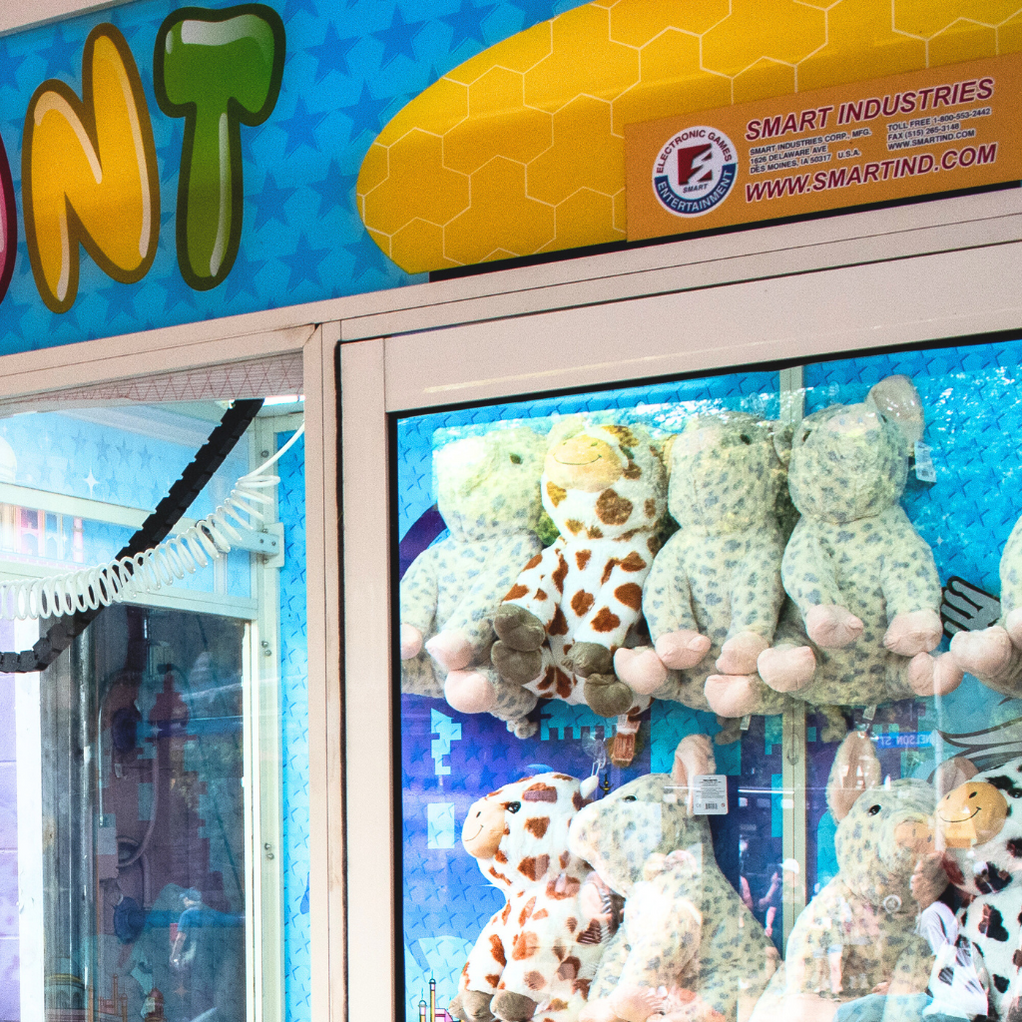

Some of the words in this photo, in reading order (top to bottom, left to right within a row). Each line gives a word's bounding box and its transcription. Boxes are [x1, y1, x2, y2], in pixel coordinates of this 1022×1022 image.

[745, 106, 833, 140] SMART
[838, 78, 994, 124] INDUSTRIES
[888, 123, 908, 131] TOLL
[910, 118, 931, 127] FREE
[934, 108, 991, 123] 1-800-553-2442
[750, 144, 776, 156] SMART
[777, 137, 823, 151] INDUSTRIES
[852, 129, 872, 138] MFG.
[888, 132, 903, 141] FAX
[904, 129, 924, 139] (515)
[926, 123, 959, 134] 265-3148
[888, 130, 975, 150] WWW.SMARTIND.COM
[656, 129, 706, 174] ELECTRONIC
[707, 132, 733, 162] GAMES
[750, 165, 766, 174] DES
[767, 161, 799, 172] MOINES,
[810, 154, 832, 164] 50317
[838, 149, 860, 158] U.S.A.
[768, 148, 810, 160] DELAWARE
[812, 146, 827, 154] AVE
[746, 143, 997, 203] WWW.SMARTIND.COM
[658, 170, 733, 212] ENTERTAINMENT
[683, 183, 708, 193] SMART
